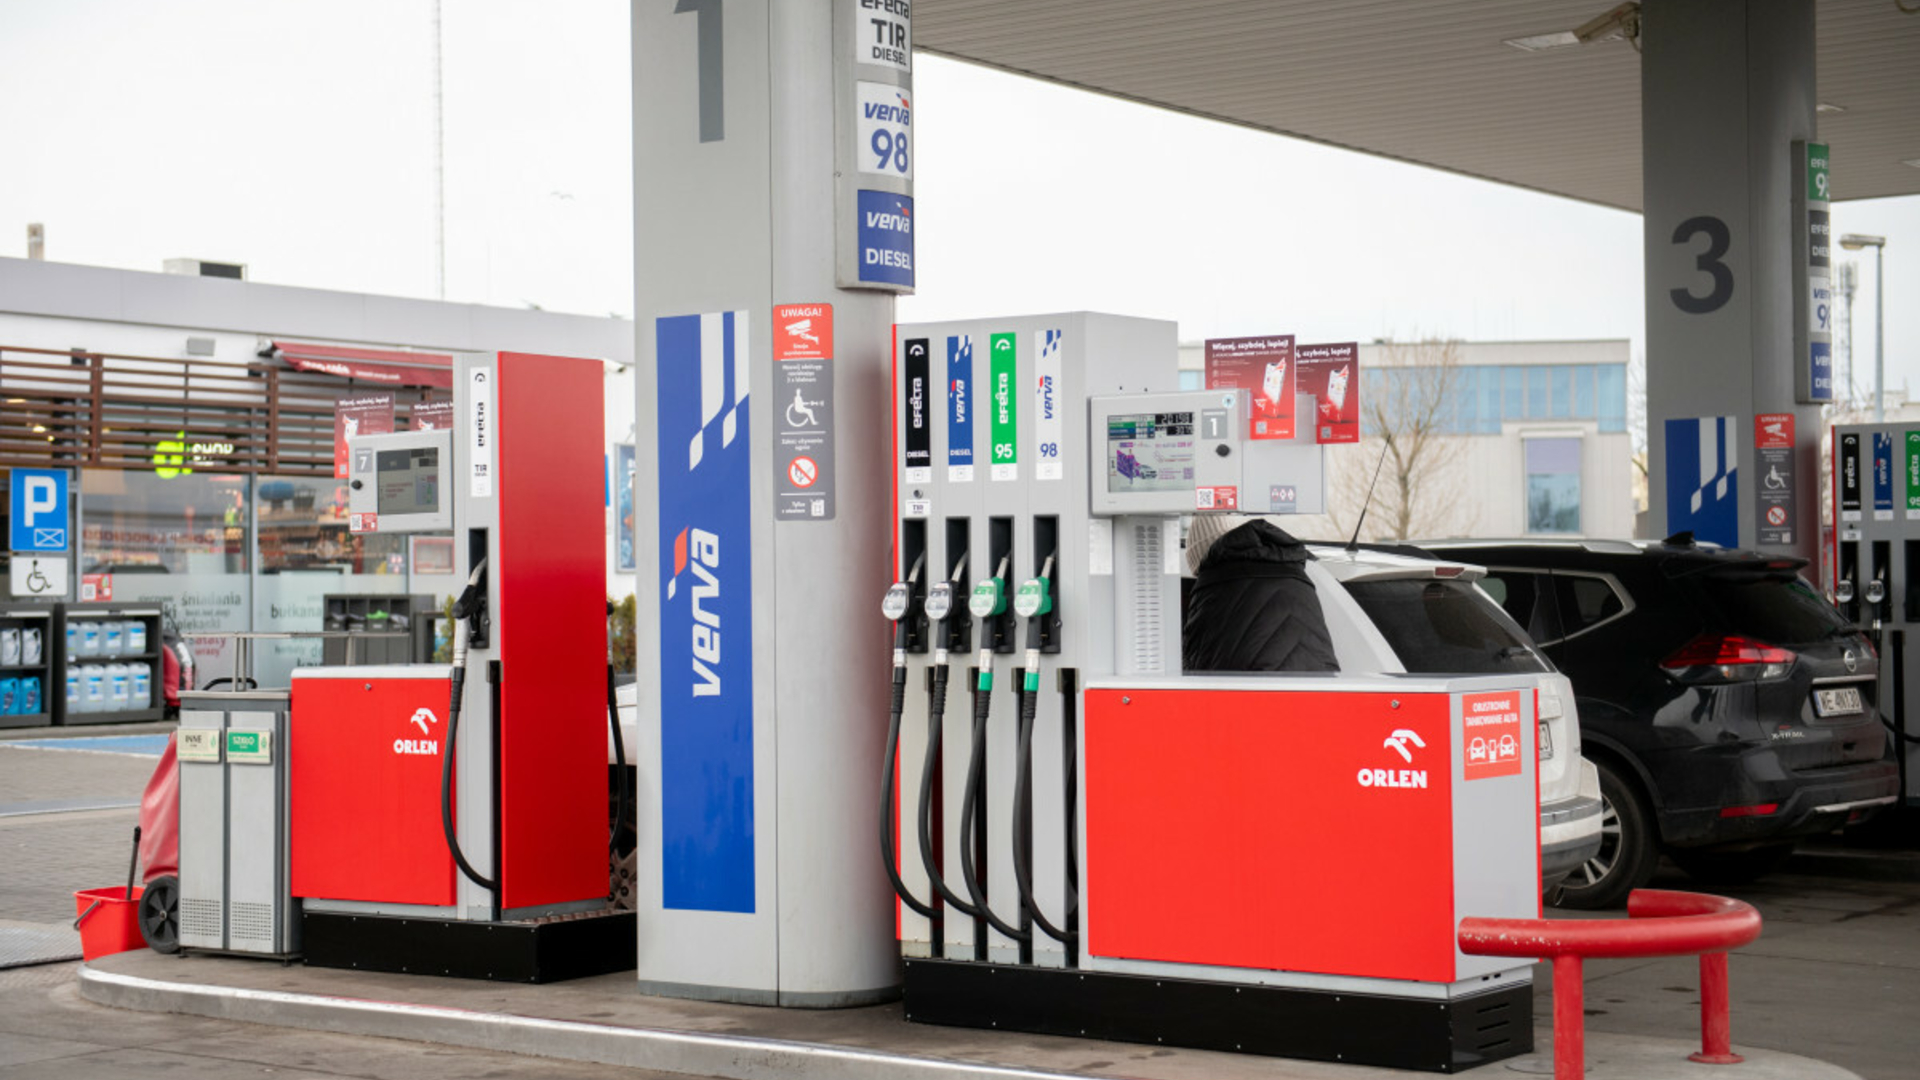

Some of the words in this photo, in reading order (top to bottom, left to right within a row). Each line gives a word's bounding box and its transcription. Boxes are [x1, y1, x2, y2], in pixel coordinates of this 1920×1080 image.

[871, 18, 905, 50] TIR
[872, 47, 907, 66] DIESEL
[674, 0, 724, 143] 1
[864, 101, 910, 126] verva
[871, 128, 908, 173] 98
[866, 211, 910, 233] verva
[865, 247, 911, 270] DIESEL
[1670, 215, 1735, 313] 3
[781, 307, 822, 318] UWAGA!
[910, 377, 923, 428] efecta
[956, 379, 965, 423] verva
[995, 372, 1009, 424] efecta
[1044, 375, 1053, 419] verva
[1210, 417, 1218, 436] 1
[995, 443, 1012, 459] 95
[1040, 442, 1058, 457] 98
[359, 456, 368, 470] 7
[24, 476, 57, 527] P
[691, 528, 721, 697] verva
[394, 739, 438, 755] ORLEN
[1357, 768, 1427, 788] ORLEN
